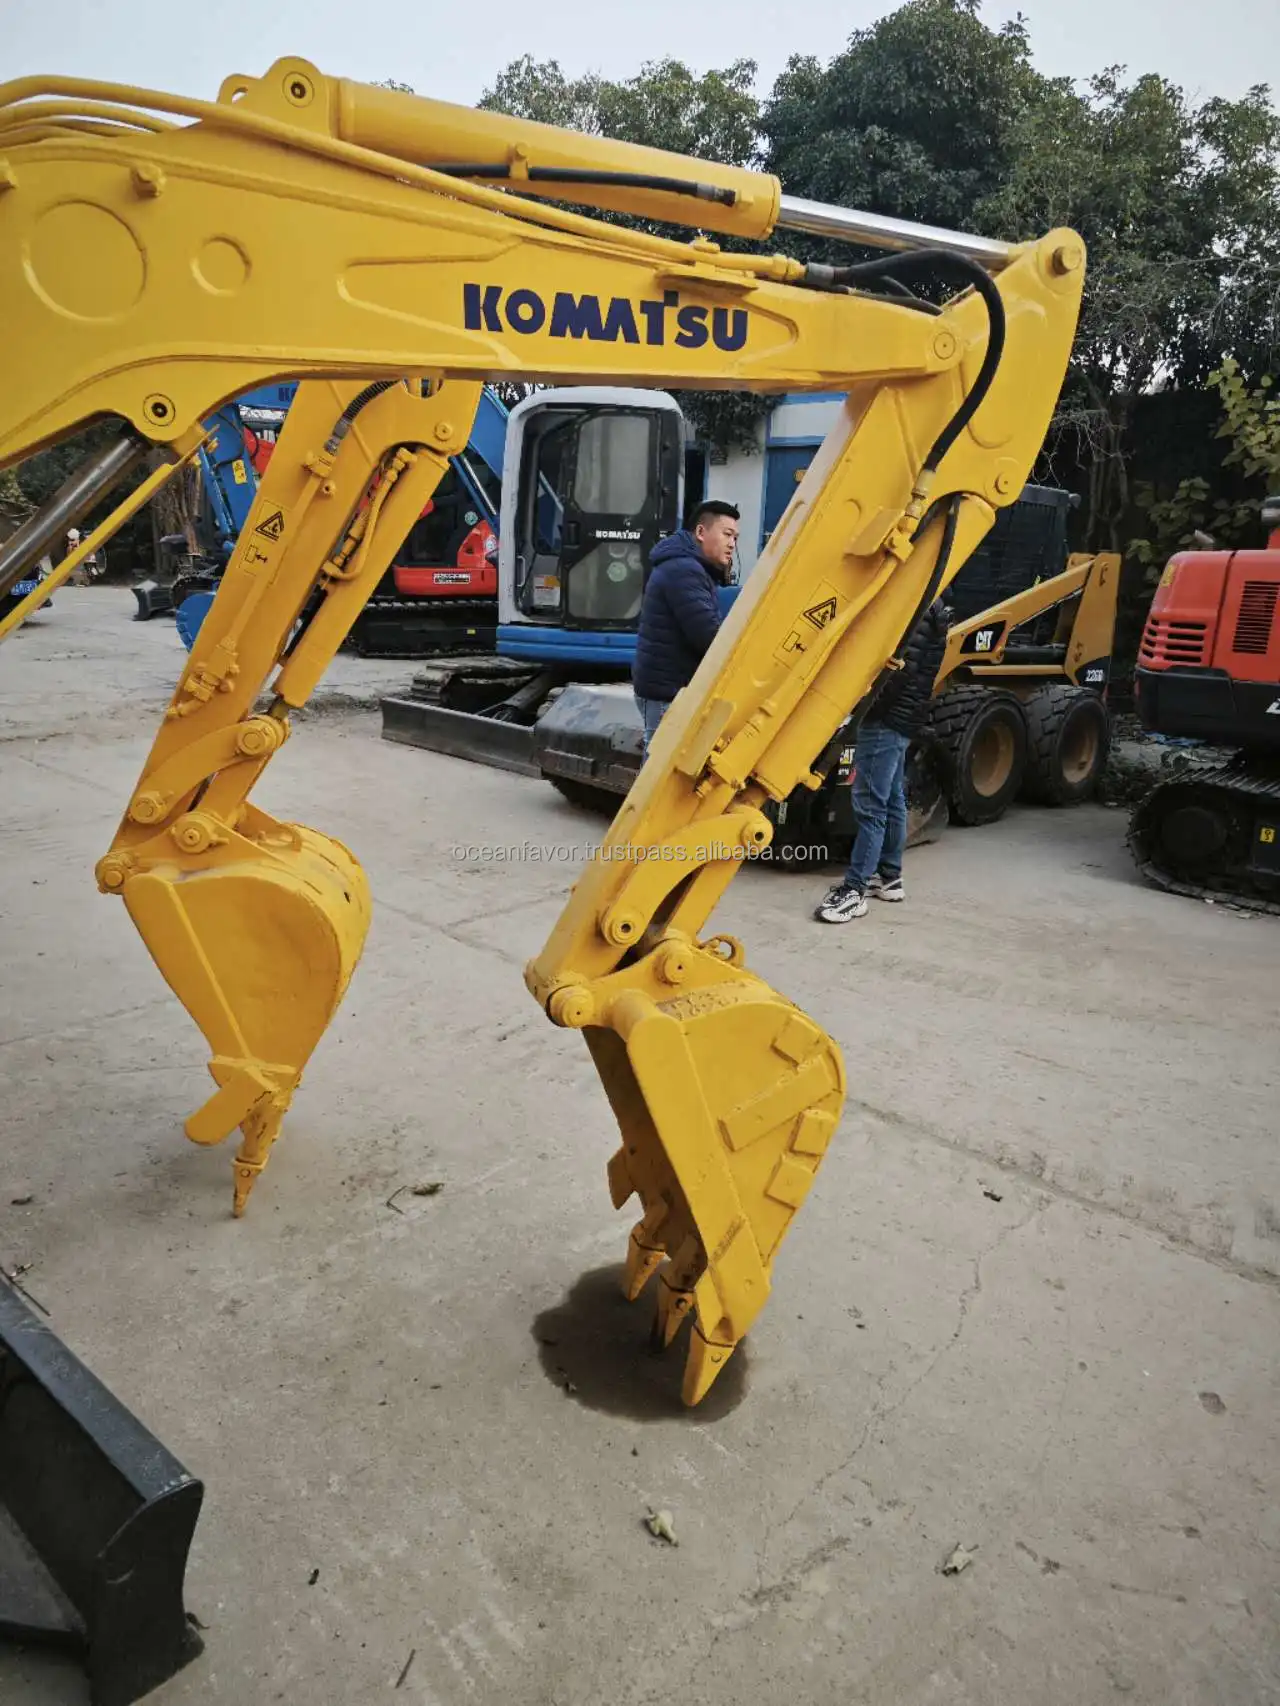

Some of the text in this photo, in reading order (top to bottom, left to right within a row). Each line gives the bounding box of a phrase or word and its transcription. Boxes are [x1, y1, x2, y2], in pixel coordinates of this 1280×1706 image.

[463, 283, 748, 351] KOMATSU
[595, 529, 641, 540] KOMATSU
[975, 630, 994, 652] CAT
